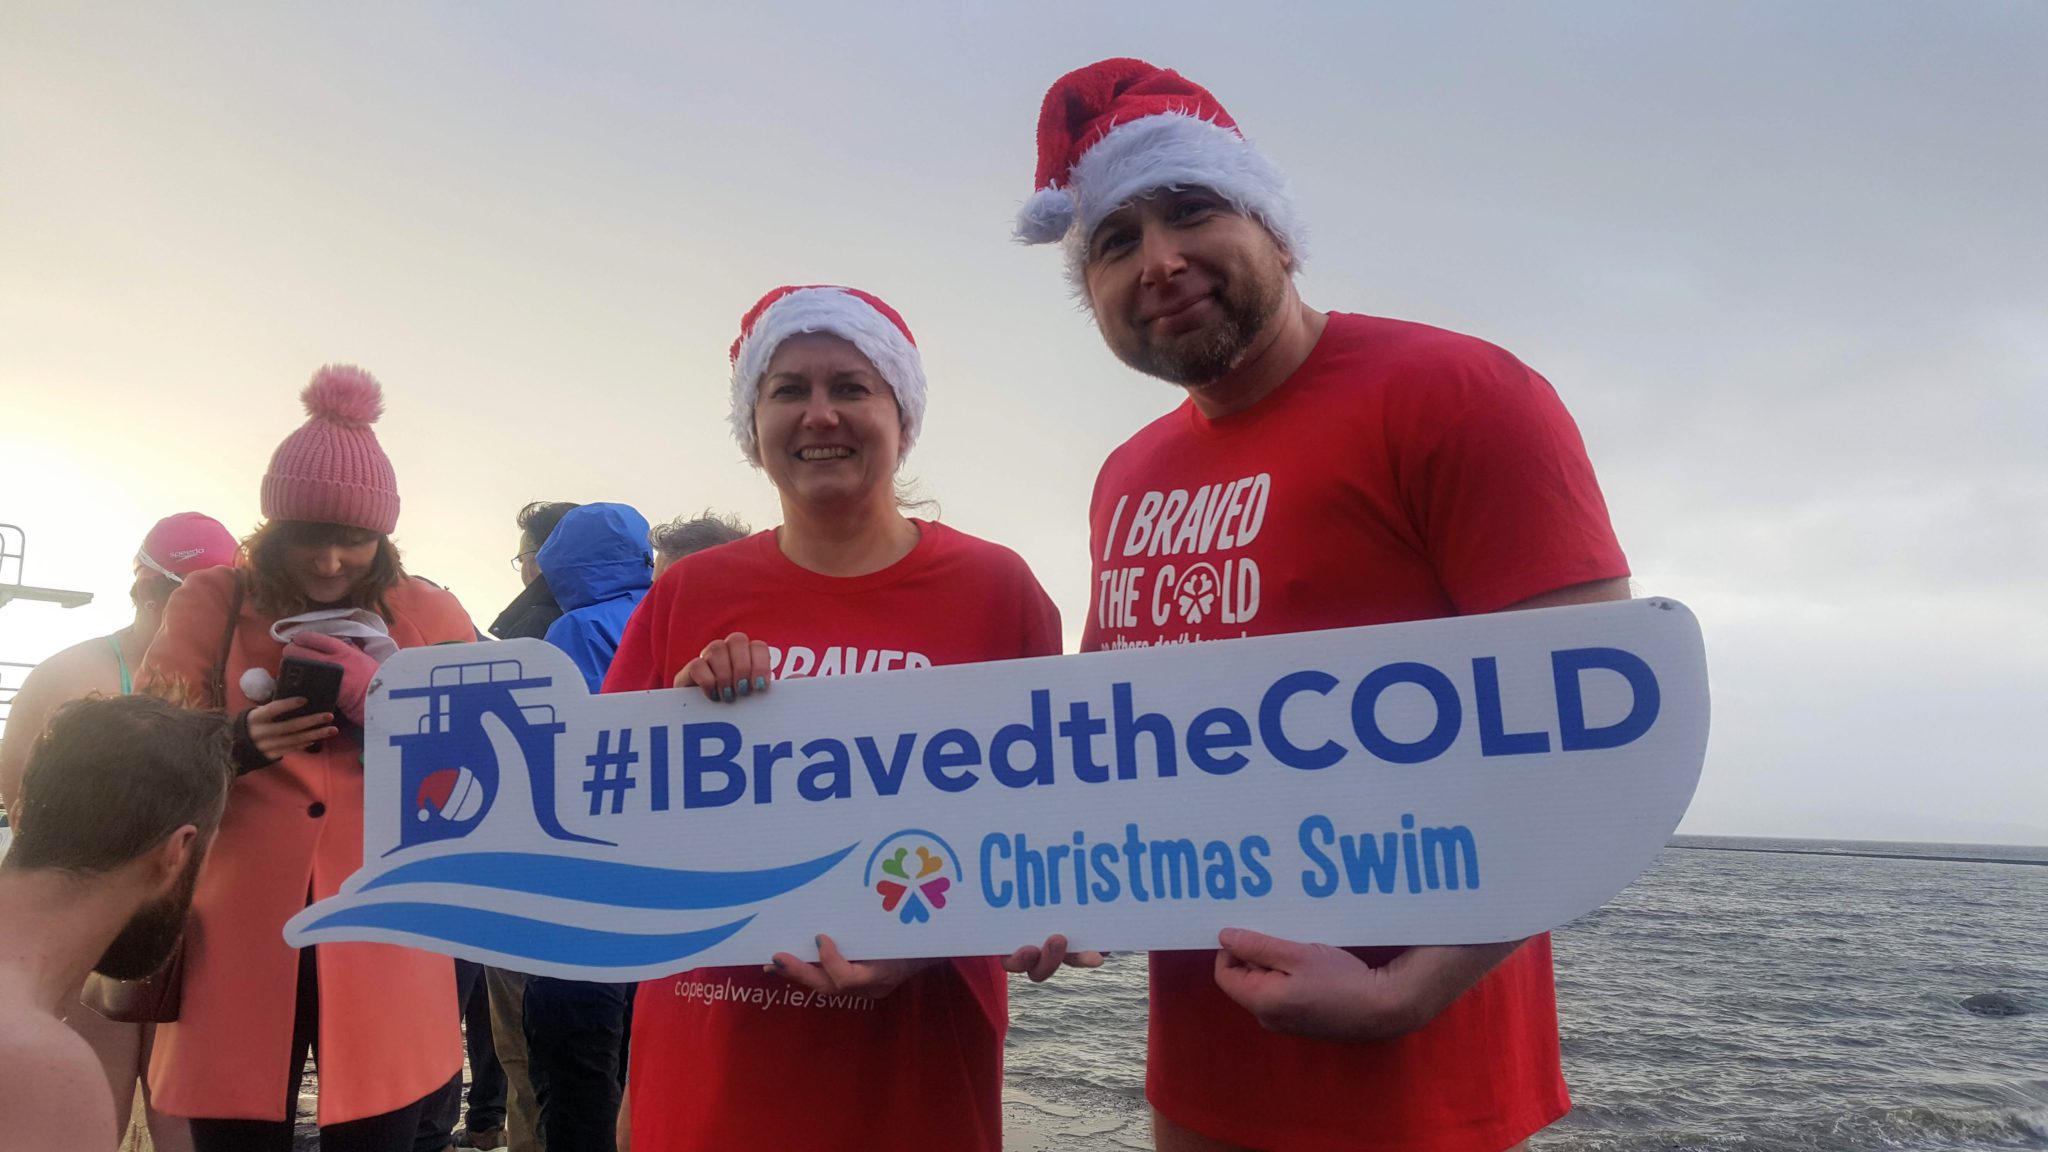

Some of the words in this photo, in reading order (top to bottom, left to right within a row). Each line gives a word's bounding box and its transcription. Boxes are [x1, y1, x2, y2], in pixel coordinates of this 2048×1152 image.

[169, 547, 205, 560] speedo
[1103, 494, 1129, 562] I
[1123, 472, 1271, 558] BRAVED
[1098, 566, 1145, 630] THE
[582, 646, 1661, 816] #IBravedtheCOLD
[979, 823, 1273, 910] Christmas
[1299, 813, 1481, 899] Swim
[674, 976, 875, 1011] copegalway.ie/swim
